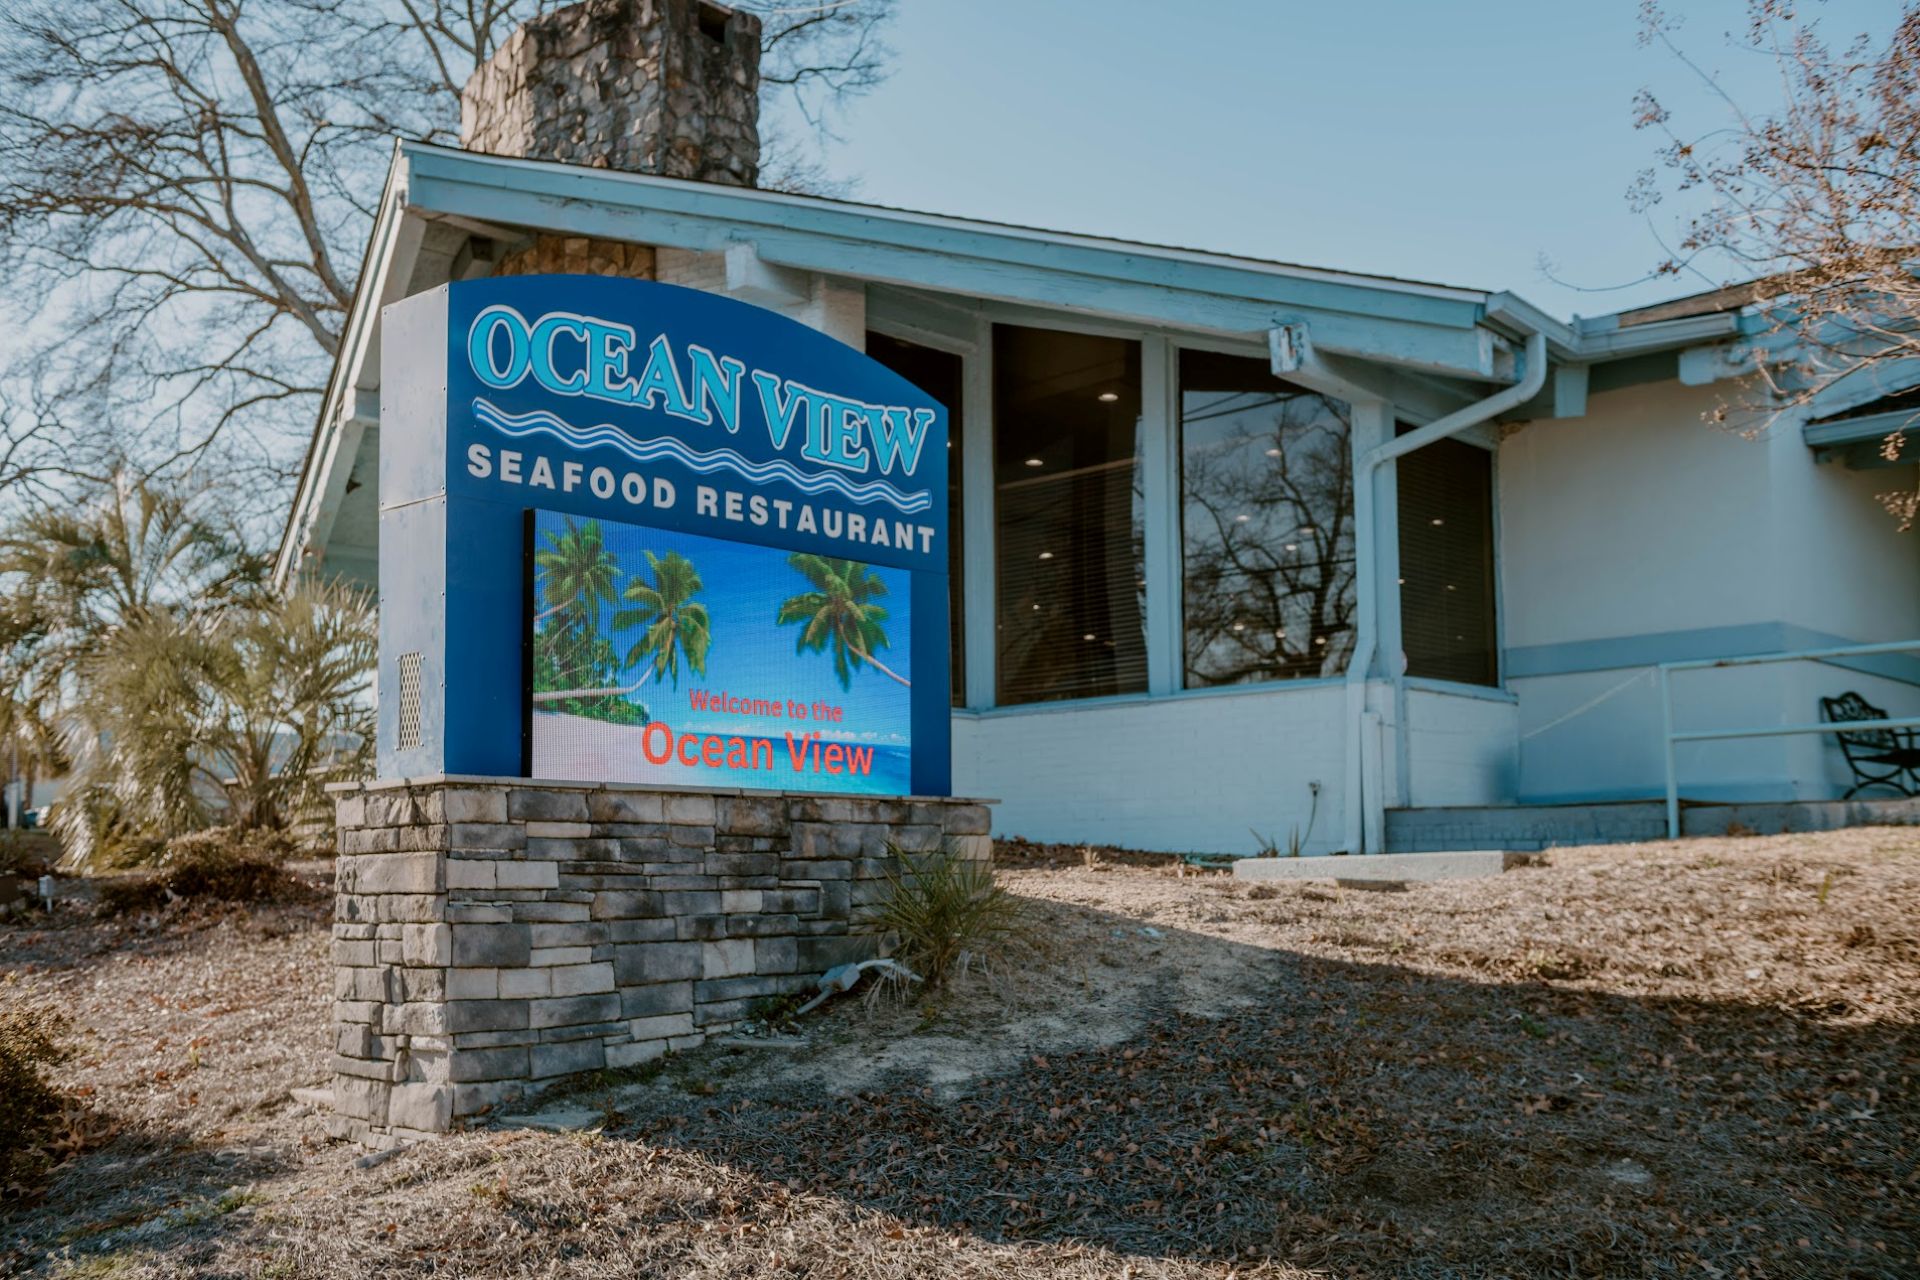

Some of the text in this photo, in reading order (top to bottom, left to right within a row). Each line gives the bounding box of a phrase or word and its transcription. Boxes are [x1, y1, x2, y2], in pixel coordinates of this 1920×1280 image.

[468, 304, 935, 476] OCEAN VIEW
[467, 443, 935, 554] SEAFOOD RESTAURANT
[688, 688, 844, 723] Welcome to the
[642, 720, 874, 775] Ocean View
